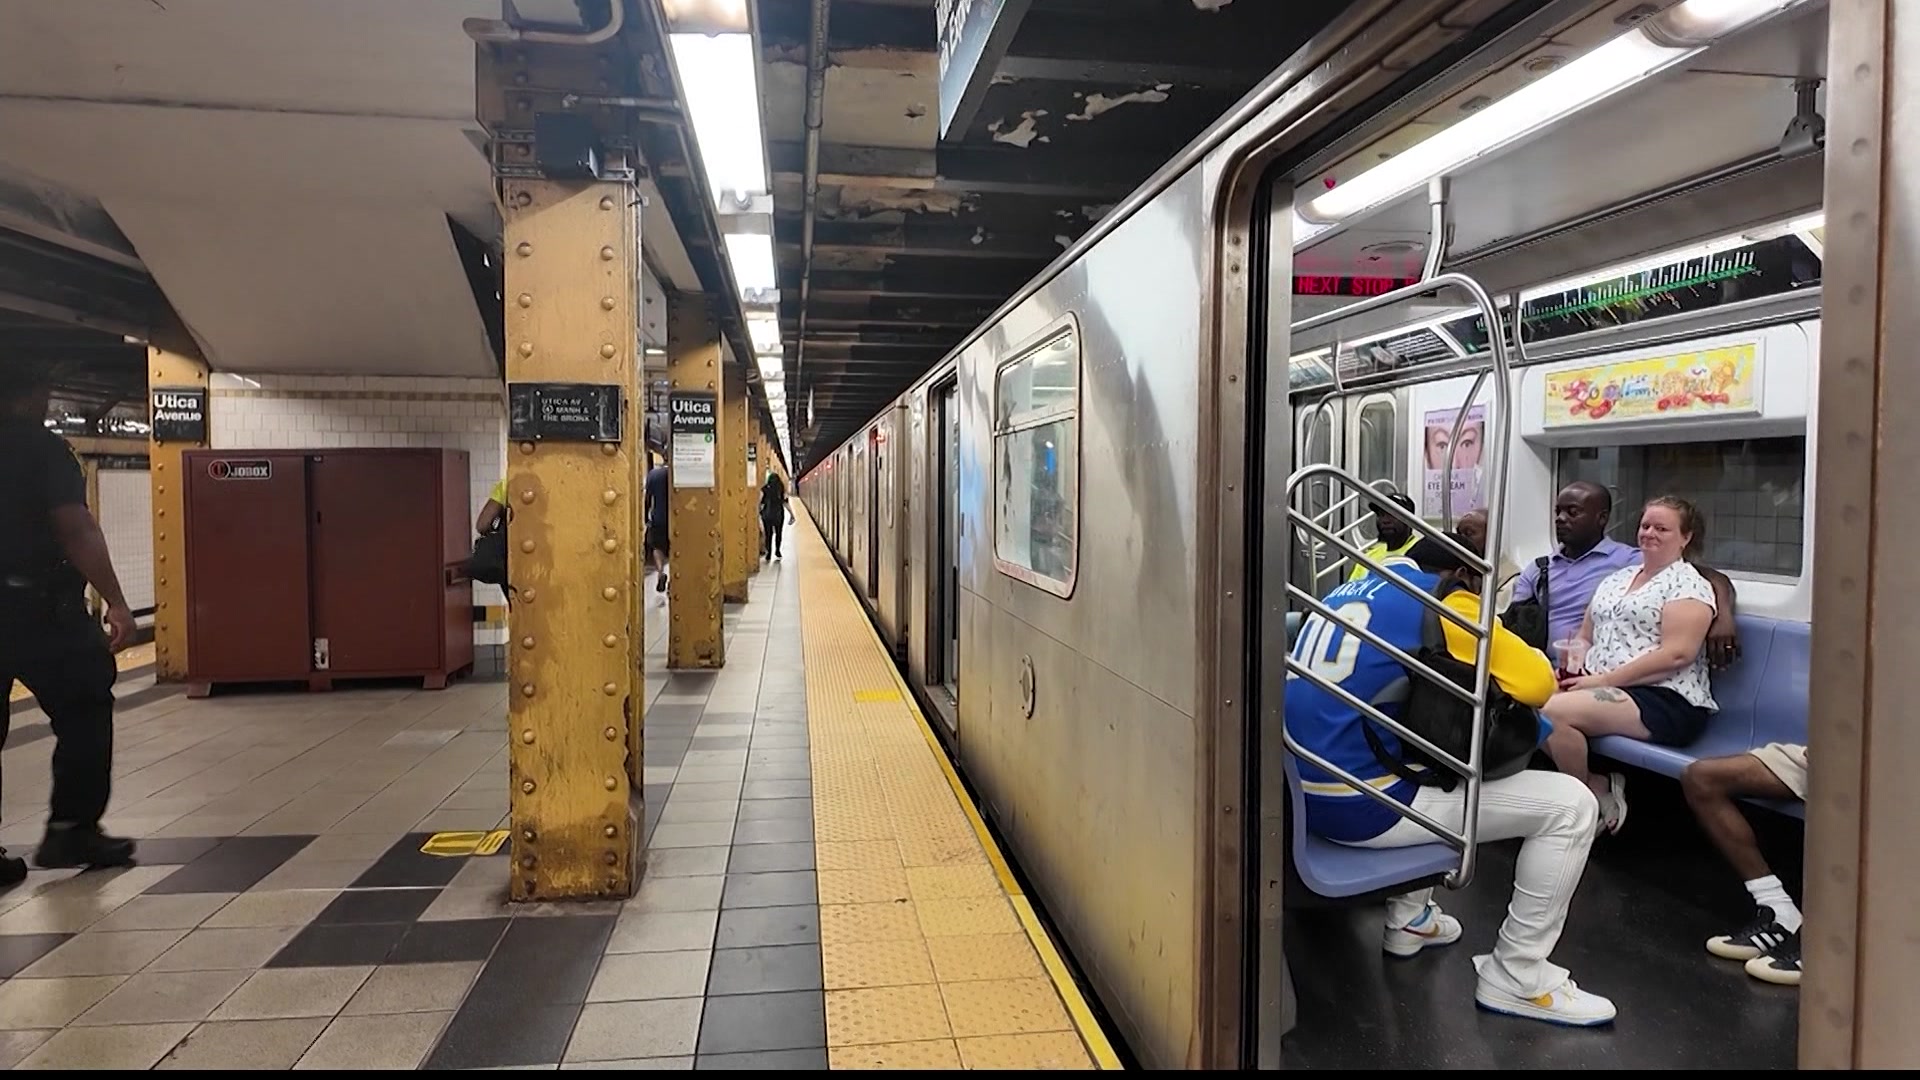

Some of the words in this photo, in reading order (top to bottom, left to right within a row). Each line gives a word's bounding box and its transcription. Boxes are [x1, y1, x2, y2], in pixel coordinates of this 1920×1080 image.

[1298, 276, 1340, 294] NEXT
[1352, 277, 1394, 295] STOP
[154, 394, 198, 409] Utica
[671, 400, 711, 413] Utica
[154, 409, 202, 421] Avenue
[673, 414, 715, 425] Avenue
[230, 466, 268, 477] JOBOX
[1427, 481, 1441, 491] EYE
